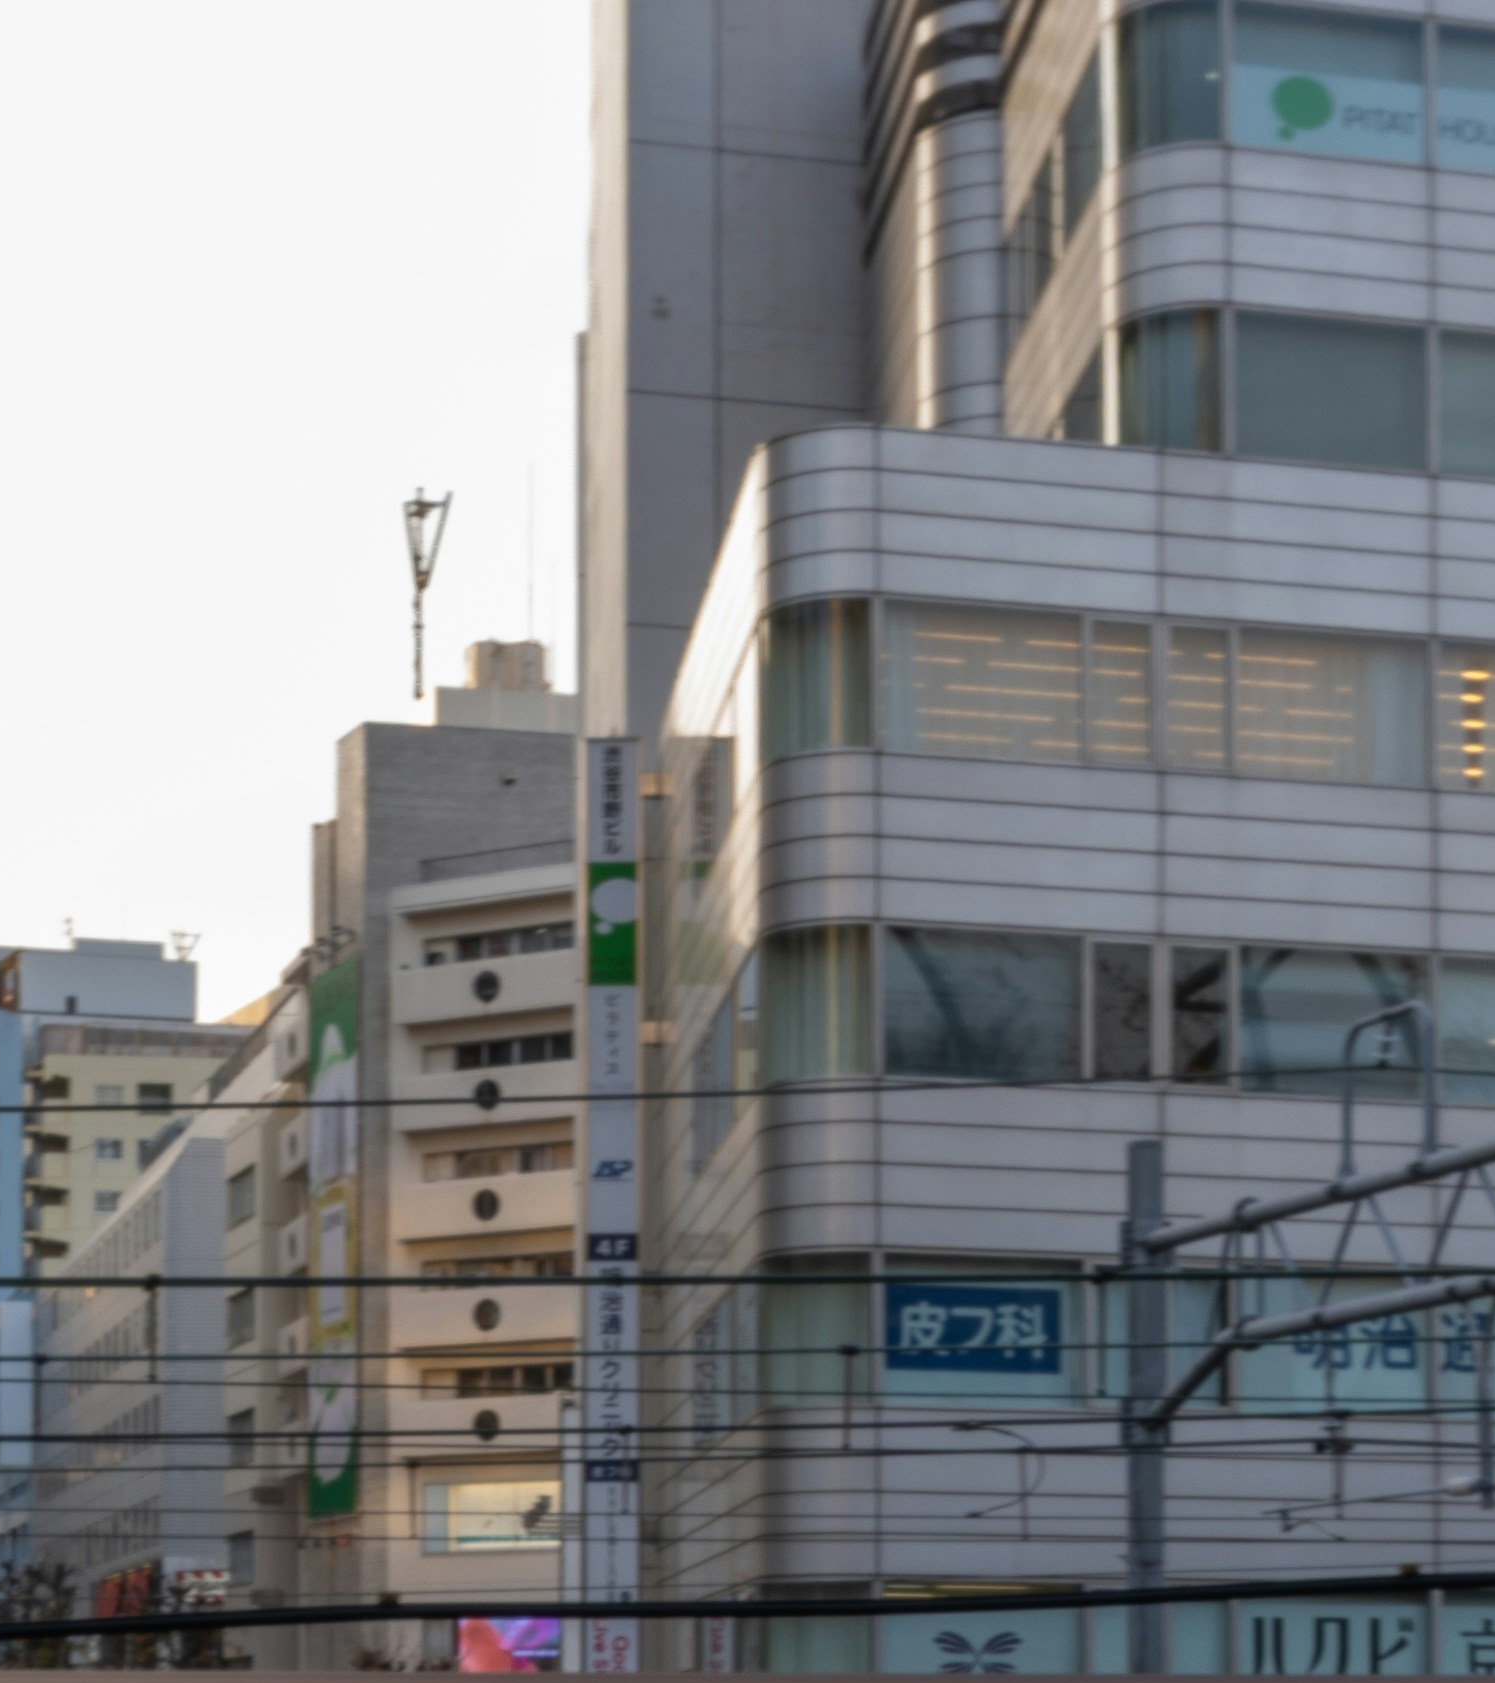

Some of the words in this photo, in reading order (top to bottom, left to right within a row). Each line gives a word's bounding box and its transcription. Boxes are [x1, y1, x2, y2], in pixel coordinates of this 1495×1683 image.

[594, 1238, 631, 1257] 4F
[899, 1301, 1049, 1360] 皮フ科
